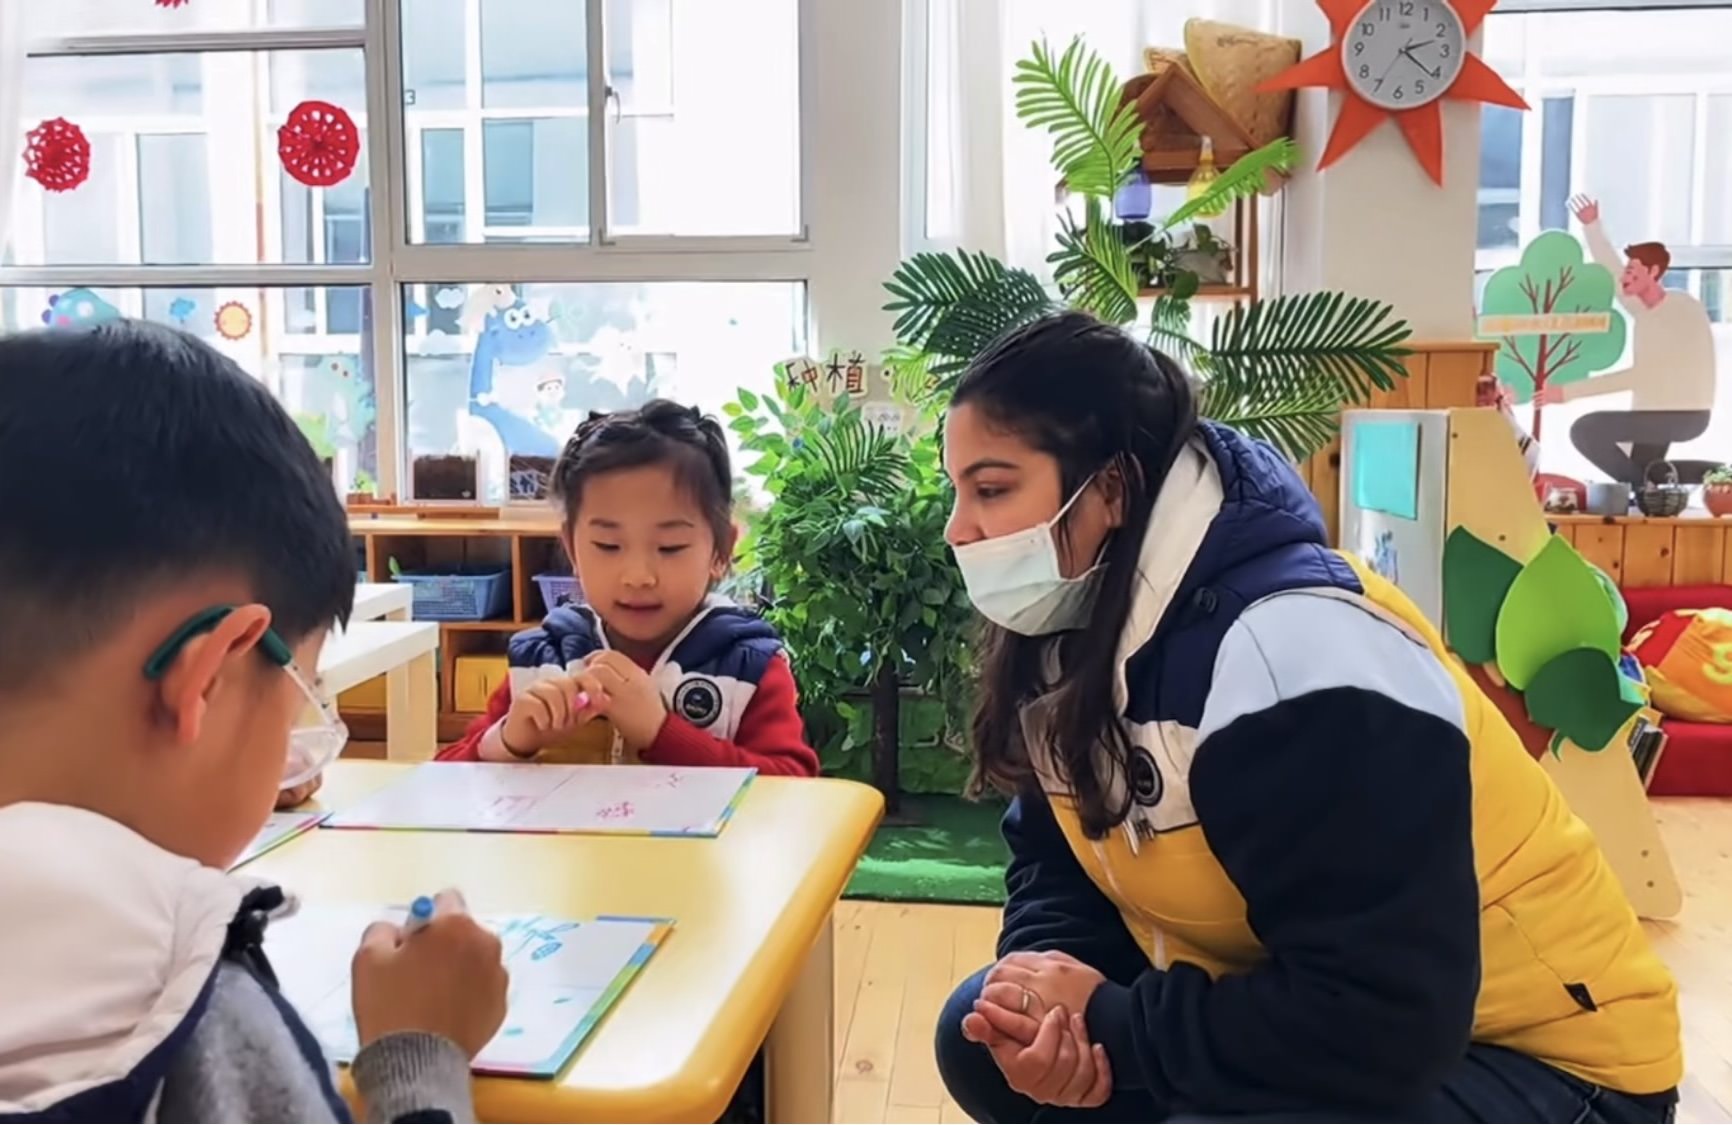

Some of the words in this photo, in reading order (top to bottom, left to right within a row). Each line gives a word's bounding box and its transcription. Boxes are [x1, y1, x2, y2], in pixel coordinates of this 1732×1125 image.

[1380, 8, 1391, 21] 11
[1399, 2, 1414, 16] 12
[1424, 7, 1429, 21] 1
[1361, 23, 1374, 36] 10
[1436, 23, 1446, 37] 2
[1354, 42, 1364, 56] 9
[1440, 44, 1450, 58] 3
[1359, 64, 1369, 79] 8
[1431, 66, 1441, 80] 4
[1374, 78, 1384, 92] 7
[1393, 85, 1403, 99] 6
[1415, 80, 1424, 94] 5
